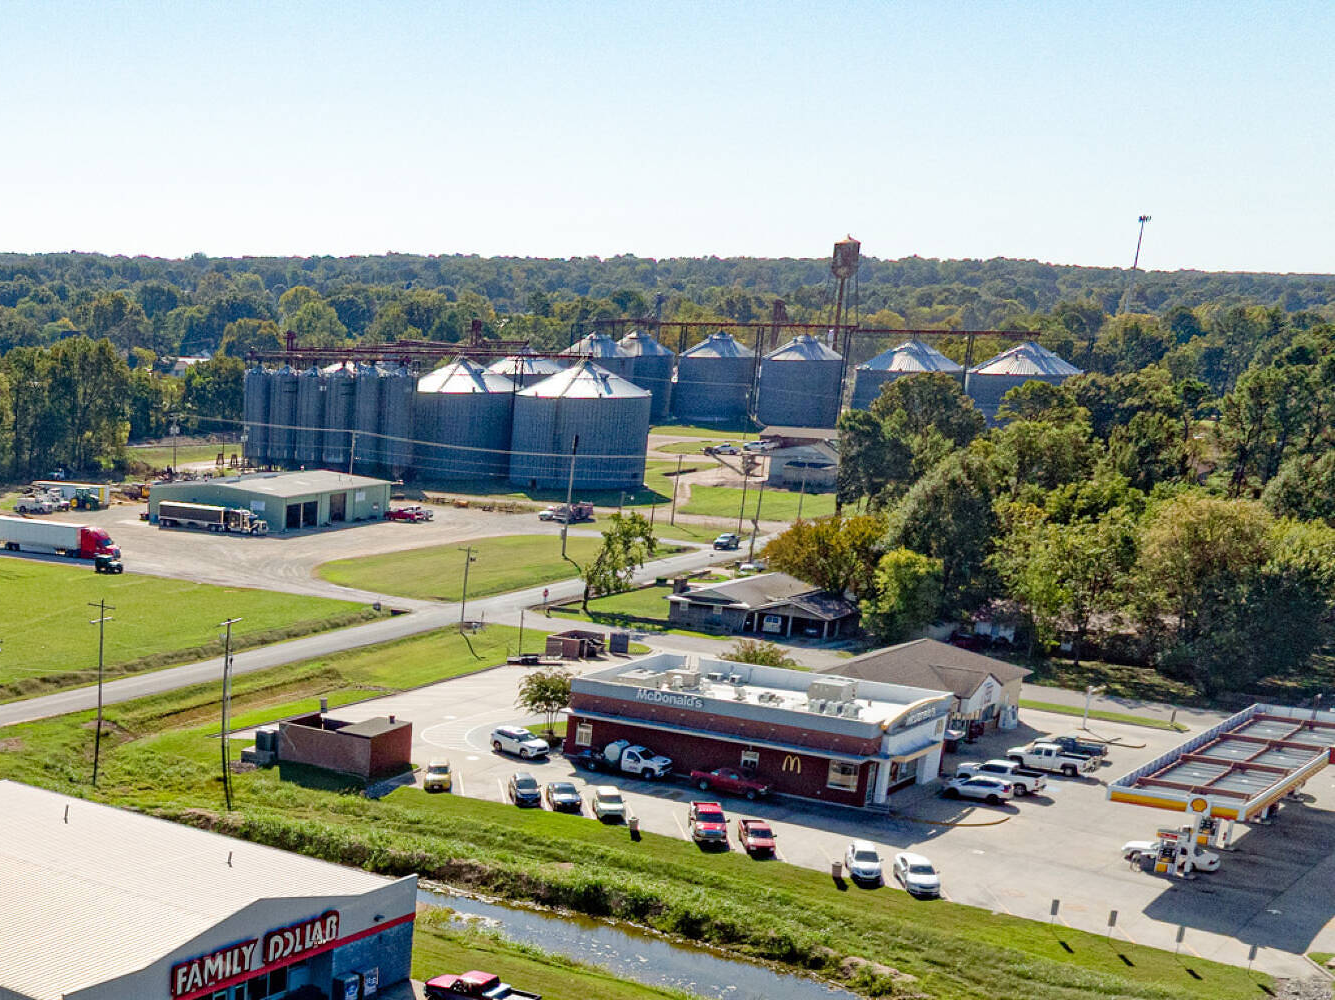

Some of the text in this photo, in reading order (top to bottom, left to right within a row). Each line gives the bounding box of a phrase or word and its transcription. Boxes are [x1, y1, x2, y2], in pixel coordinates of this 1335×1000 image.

[636, 687, 704, 708] McDonald's
[176, 915, 338, 996] FAMILY DOLLAR
